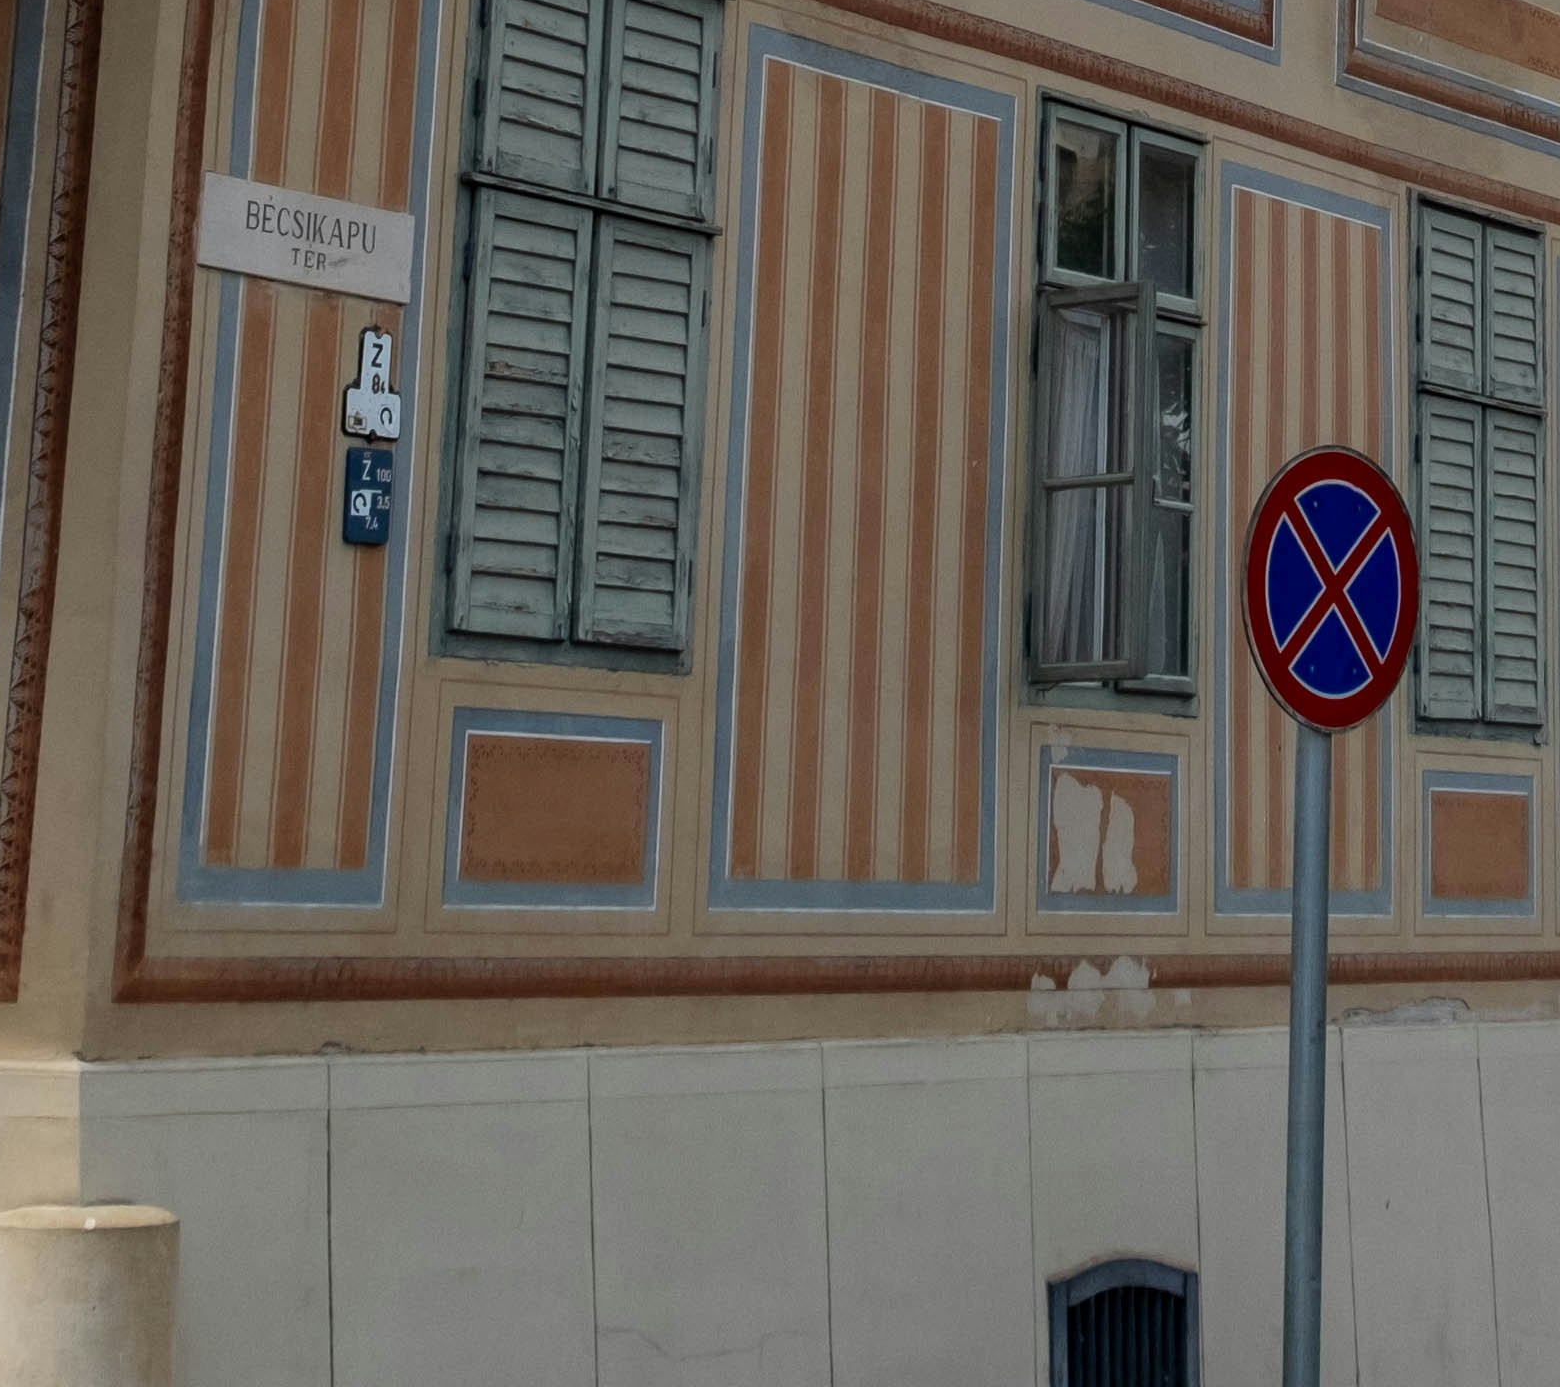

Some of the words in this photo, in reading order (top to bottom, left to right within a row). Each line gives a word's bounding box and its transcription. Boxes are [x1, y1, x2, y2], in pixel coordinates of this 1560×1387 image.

[246, 195, 376, 254] BÉCSIKAPU
[291, 244, 327, 270] TÉR
[371, 343, 383, 368] Z
[362, 460, 372, 481] Z
